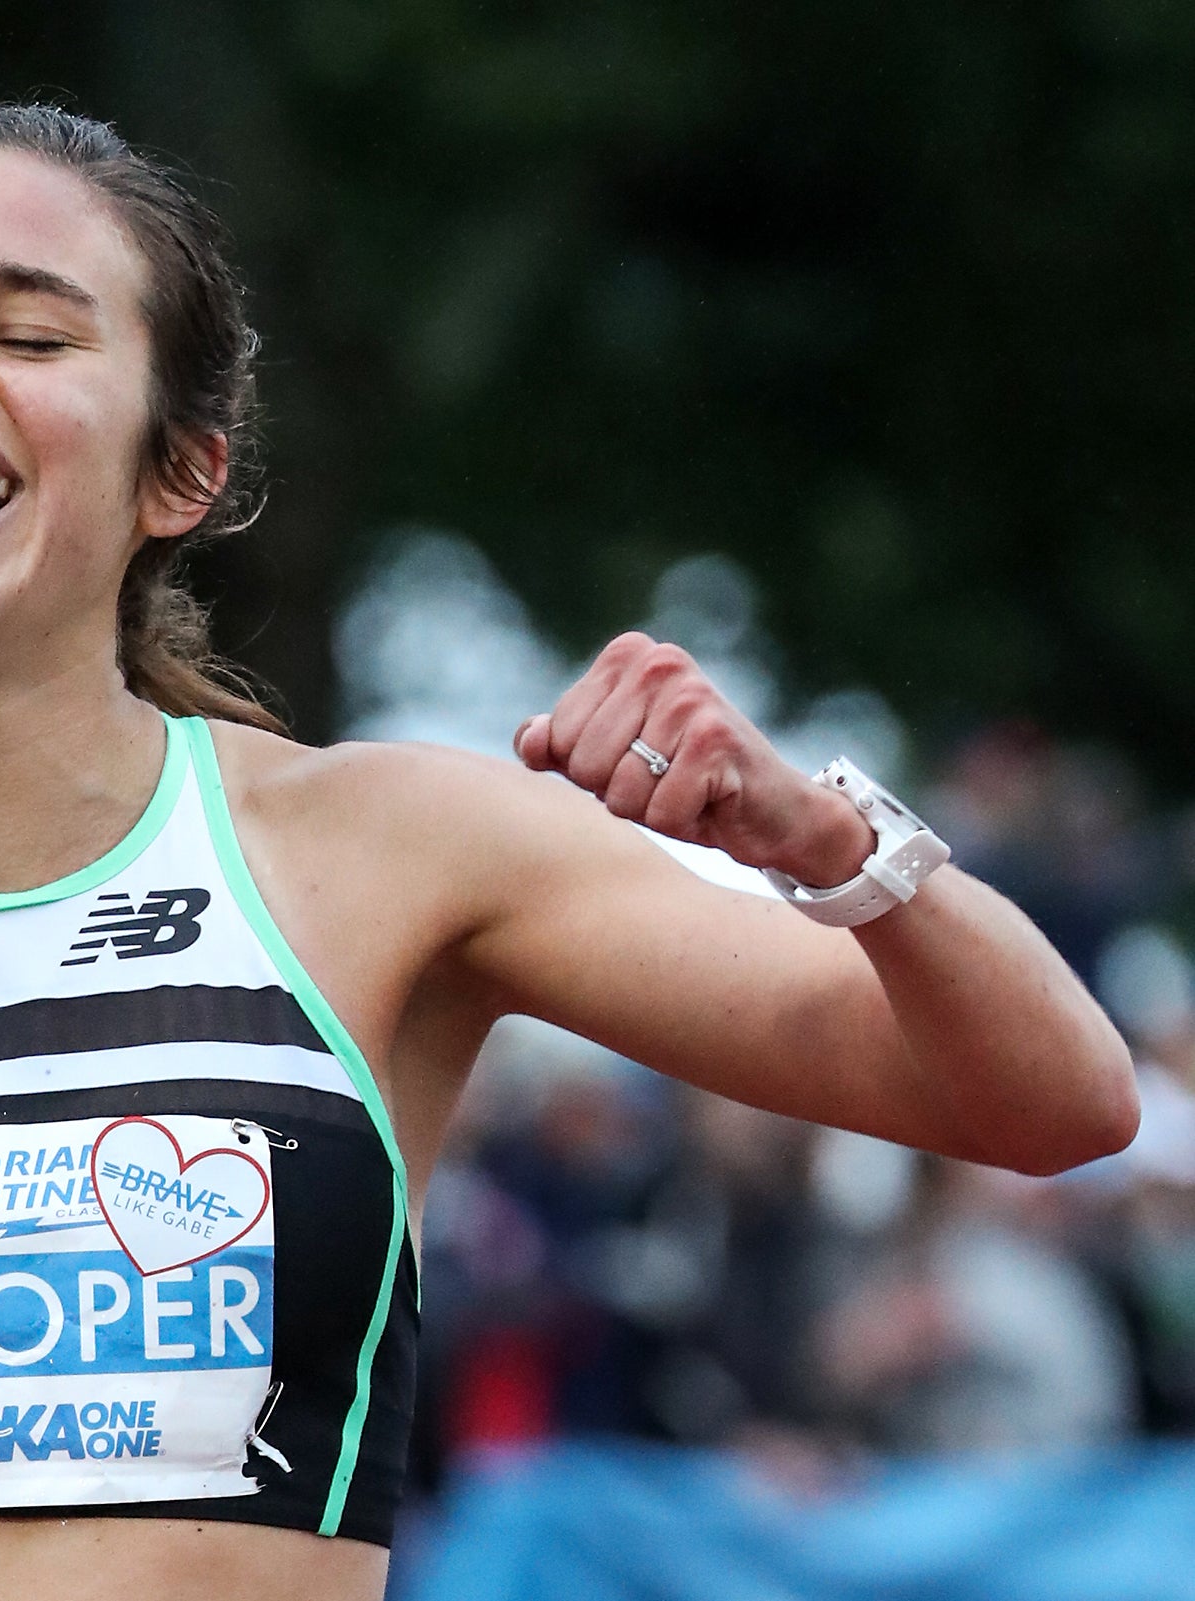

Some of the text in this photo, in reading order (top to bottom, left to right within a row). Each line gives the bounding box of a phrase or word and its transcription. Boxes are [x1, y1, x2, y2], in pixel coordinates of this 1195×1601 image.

[120, 1163, 226, 1222] BRAVE
[113, 1193, 216, 1239] LIKE GABE
[79, 1400, 157, 1431] ONE
[86, 1430, 162, 1460] ONE
